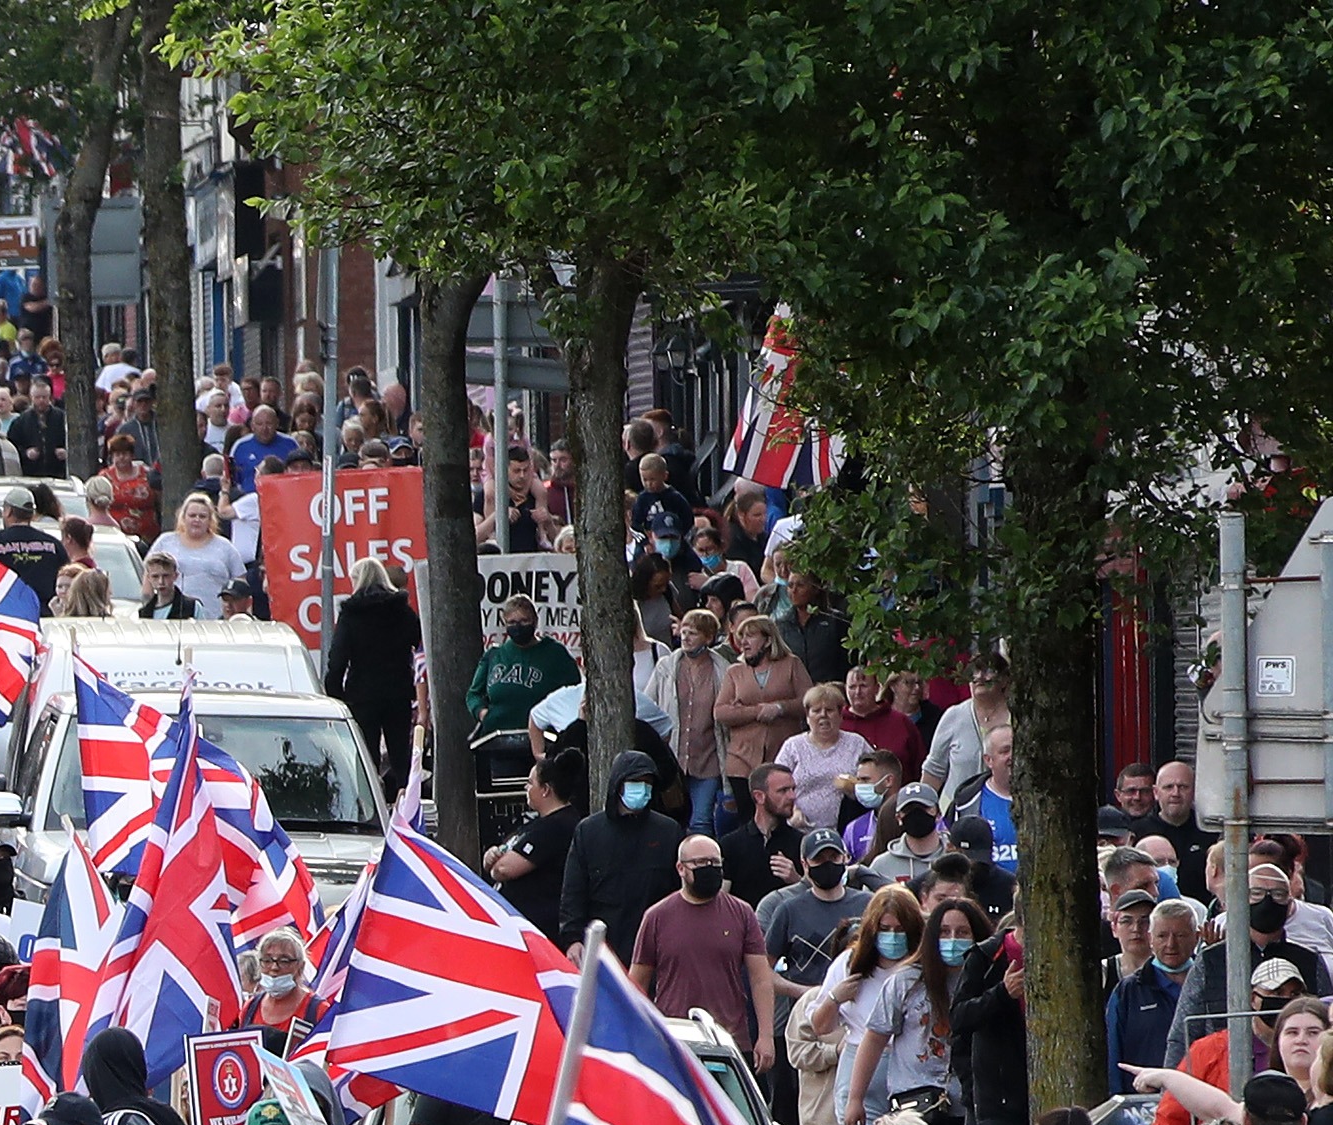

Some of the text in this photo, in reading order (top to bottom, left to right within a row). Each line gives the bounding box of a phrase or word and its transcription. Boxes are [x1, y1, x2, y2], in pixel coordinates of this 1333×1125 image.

[17, 228, 37, 248] 11
[309, 488, 389, 528] OFF
[545, 607, 580, 626] MEA
[488, 664, 543, 688] GAP
